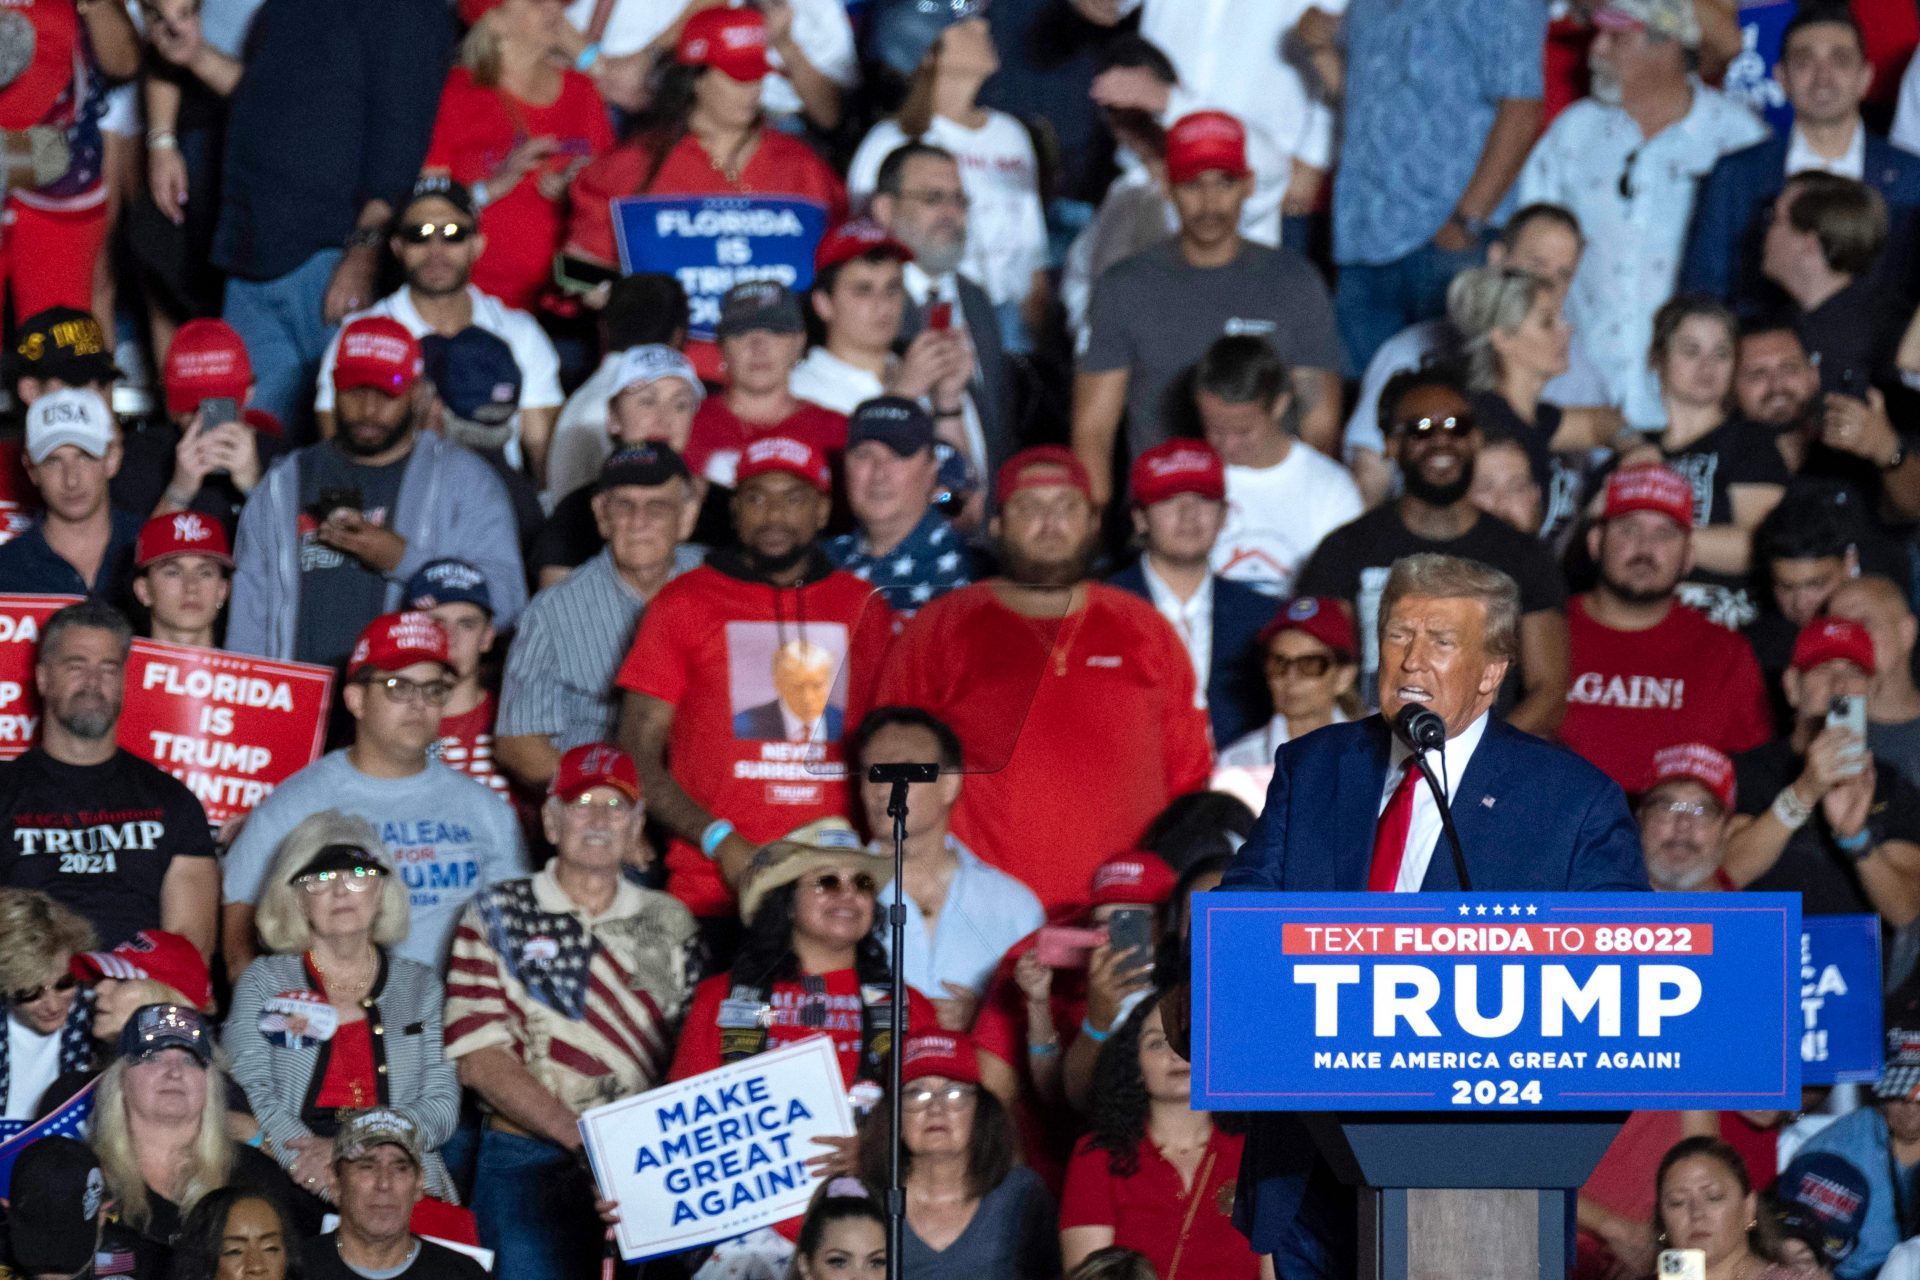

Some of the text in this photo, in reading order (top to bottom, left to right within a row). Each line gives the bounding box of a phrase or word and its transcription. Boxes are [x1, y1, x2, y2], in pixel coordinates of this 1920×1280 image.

[656, 209, 804, 238] FLORIDA
[716, 236, 752, 265] IS
[43, 403, 90, 426] USA
[143, 662, 293, 712] FLORIDA
[1567, 671, 1685, 710] GAIN!
[199, 705, 235, 736] IS
[150, 730, 272, 774] TRUMP
[14, 820, 165, 856] TRUMP
[59, 852, 118, 874] 2024
[1304, 927, 1692, 952] TEXT FLORIDA TO 88022
[1293, 964, 1703, 1038] TRUMP
[1314, 1052, 1681, 1069] MAKE AMERICA GREAT AGAIN!
[656, 1076, 770, 1132] MAKE
[1452, 1080, 1543, 1104] 2024
[352, 1110, 414, 1131] TRUMP
[634, 1098, 813, 1174] AMERICA
[664, 1132, 793, 1194] GREAT
[671, 1160, 808, 1226] AGAIN!
